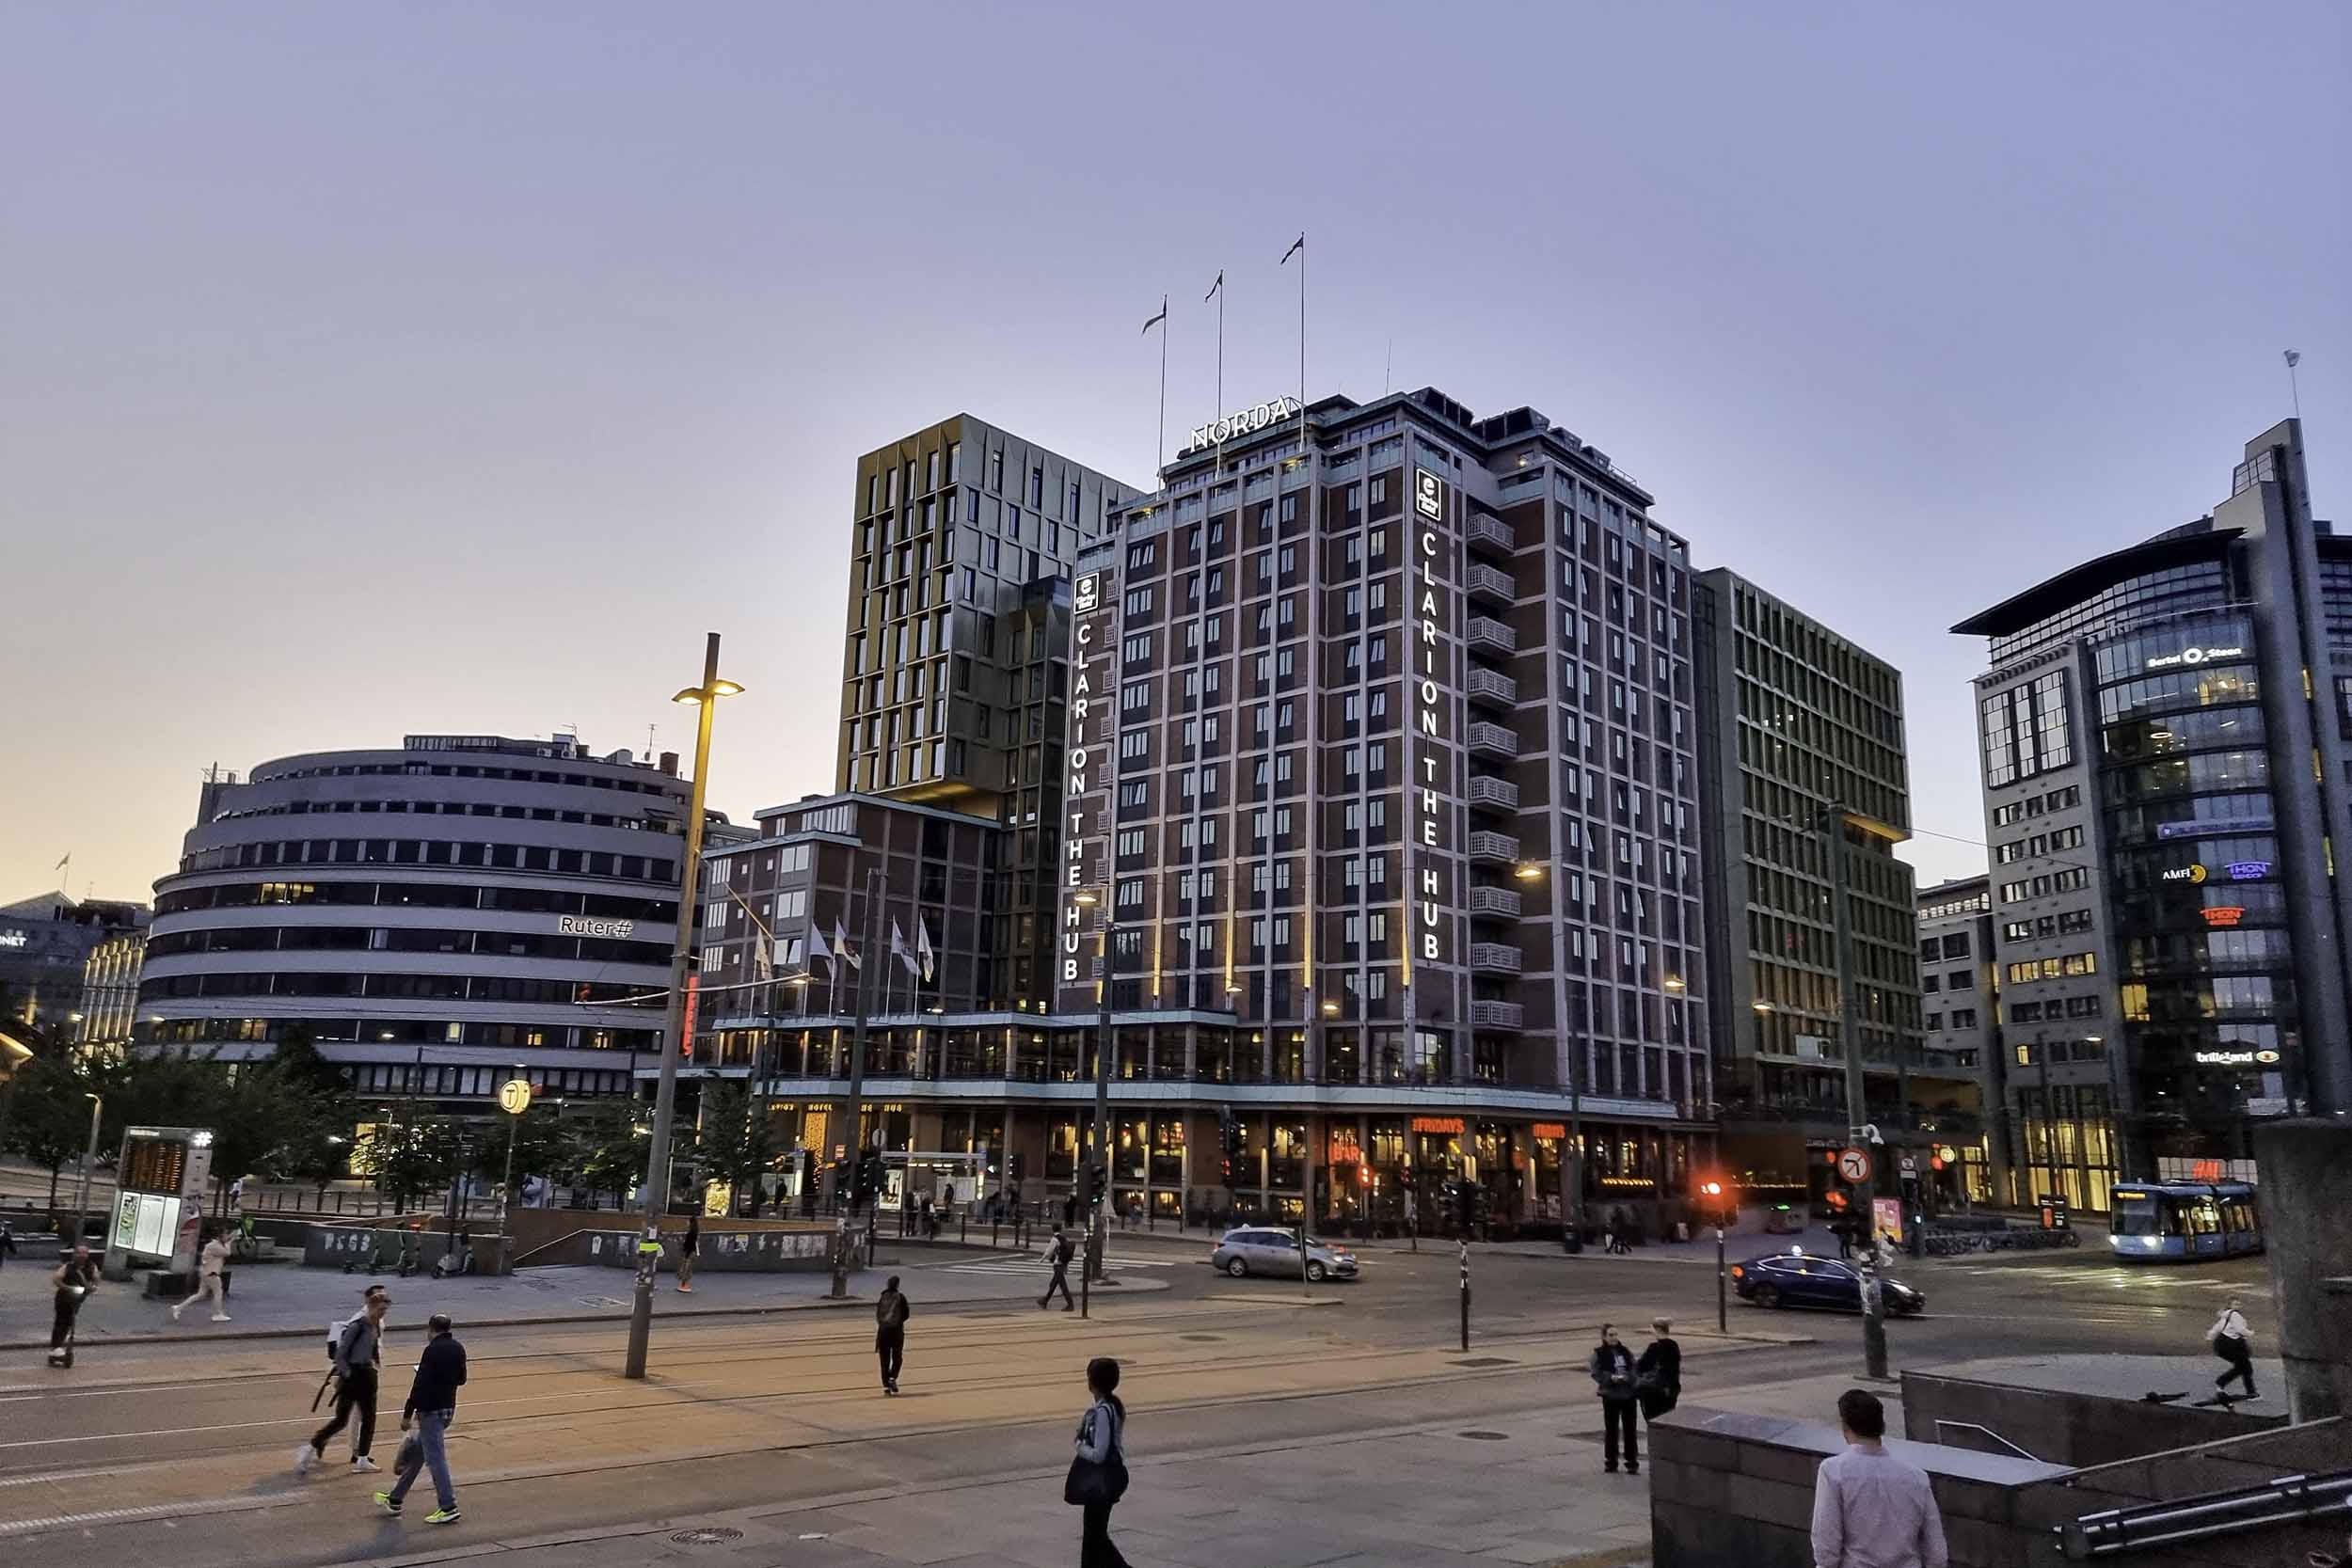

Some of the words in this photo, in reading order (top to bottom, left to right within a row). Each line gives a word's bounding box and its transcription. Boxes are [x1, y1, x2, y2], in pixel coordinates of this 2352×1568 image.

[1189, 395, 1292, 453] NORDA
[1422, 531, 1438, 736] CLARION
[1072, 624, 1092, 795] CLARION
[1422, 757, 1438, 847] THE
[1069, 813, 1084, 886] THE
[2162, 867, 2191, 880] AMFI
[1064, 906, 1080, 980] HUB
[1423, 868, 1439, 960] HUB
